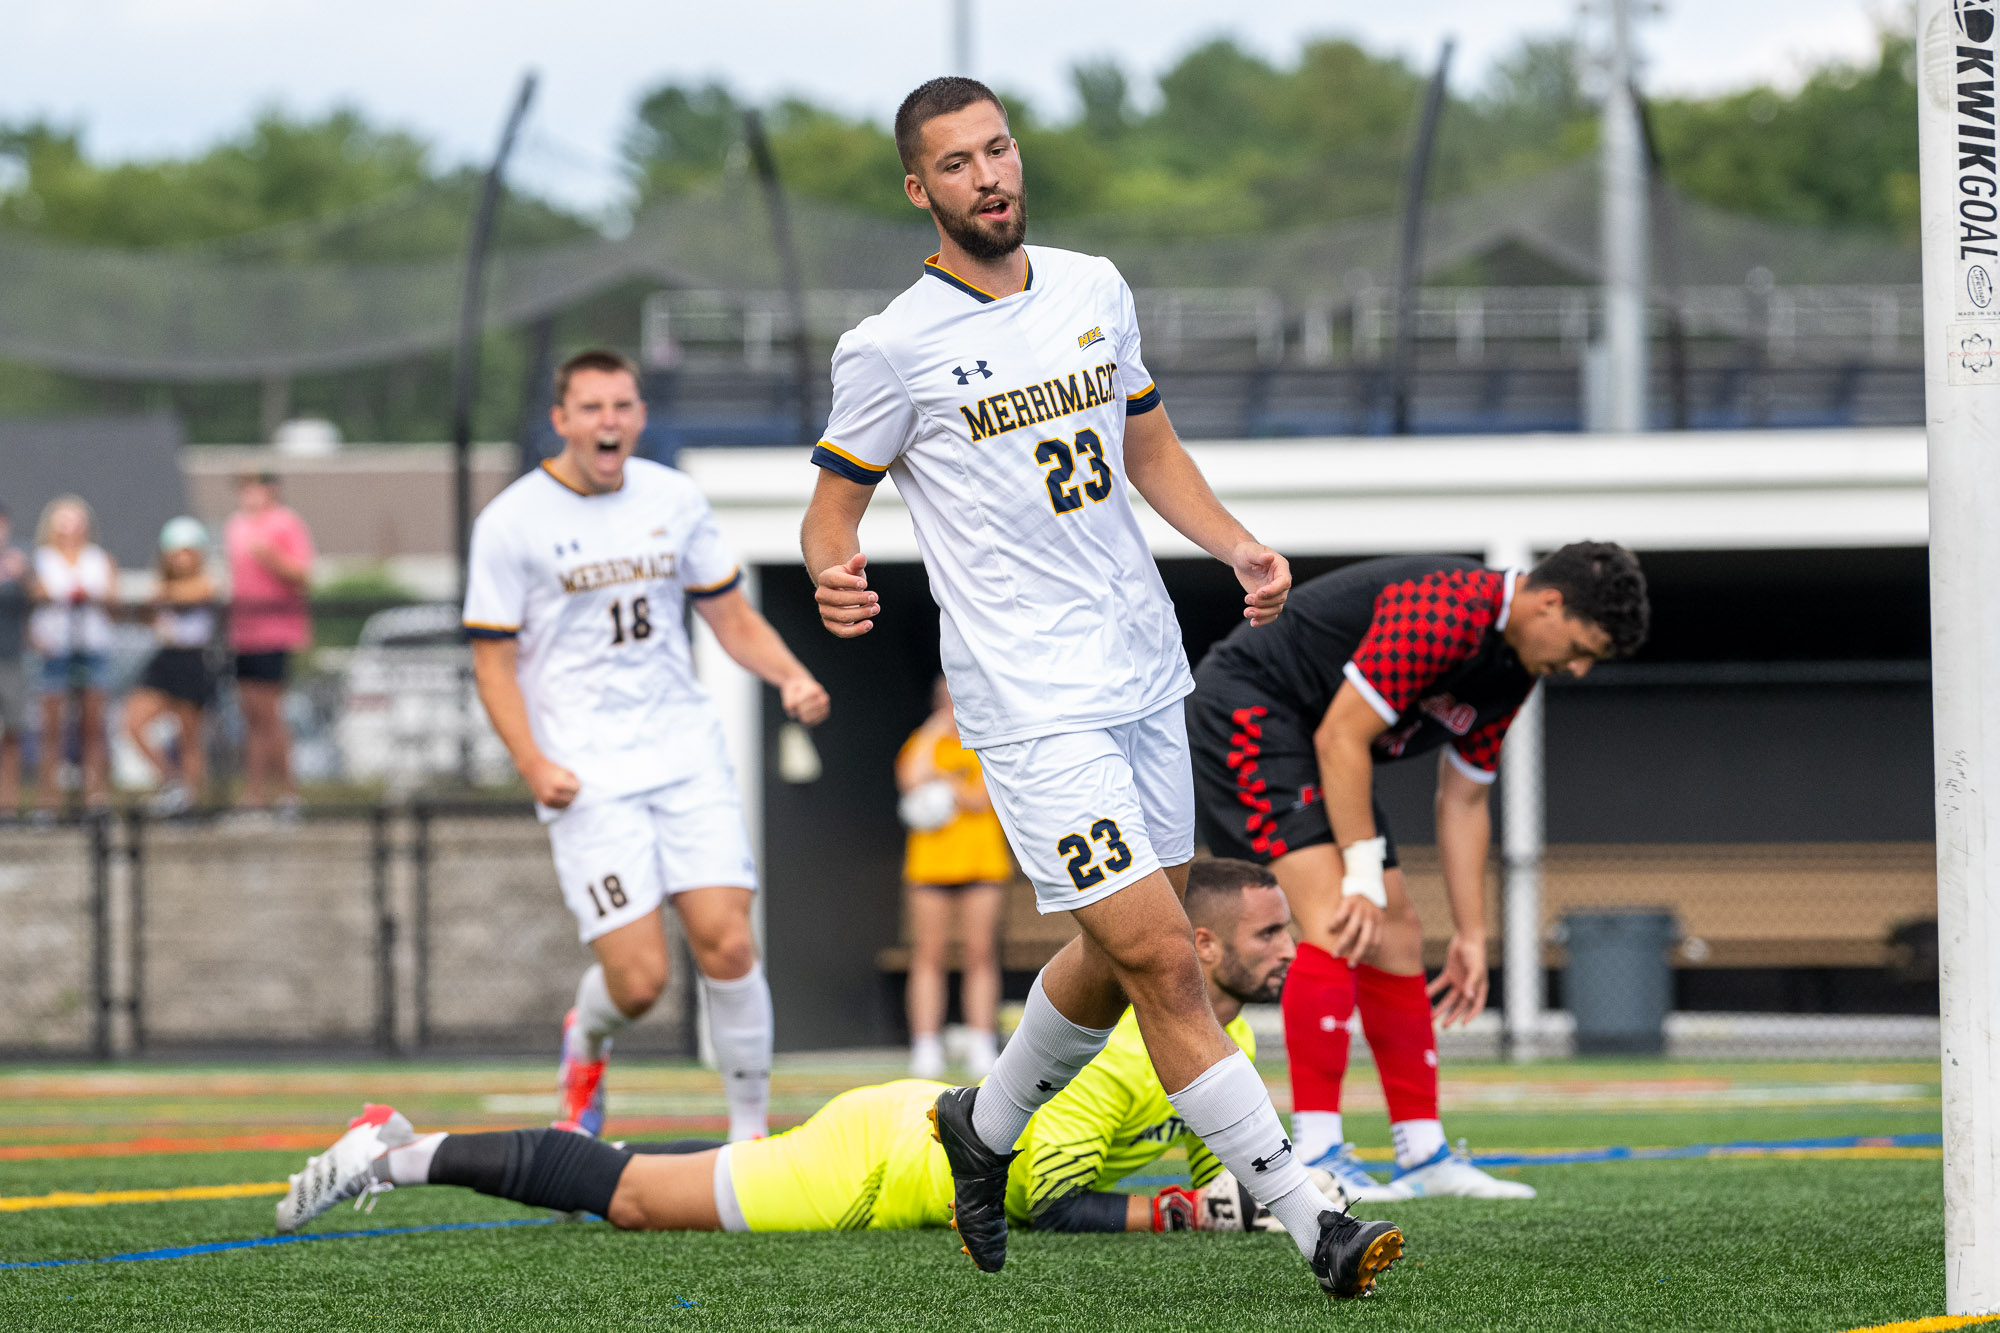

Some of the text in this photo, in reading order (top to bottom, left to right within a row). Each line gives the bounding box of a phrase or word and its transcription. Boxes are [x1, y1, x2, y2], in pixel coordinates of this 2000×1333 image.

[1078, 326, 1101, 348] NEC
[1034, 427, 1112, 516] 23
[610, 597, 652, 646] 18
[1056, 817, 1133, 892] 23
[587, 874, 628, 917] 18
